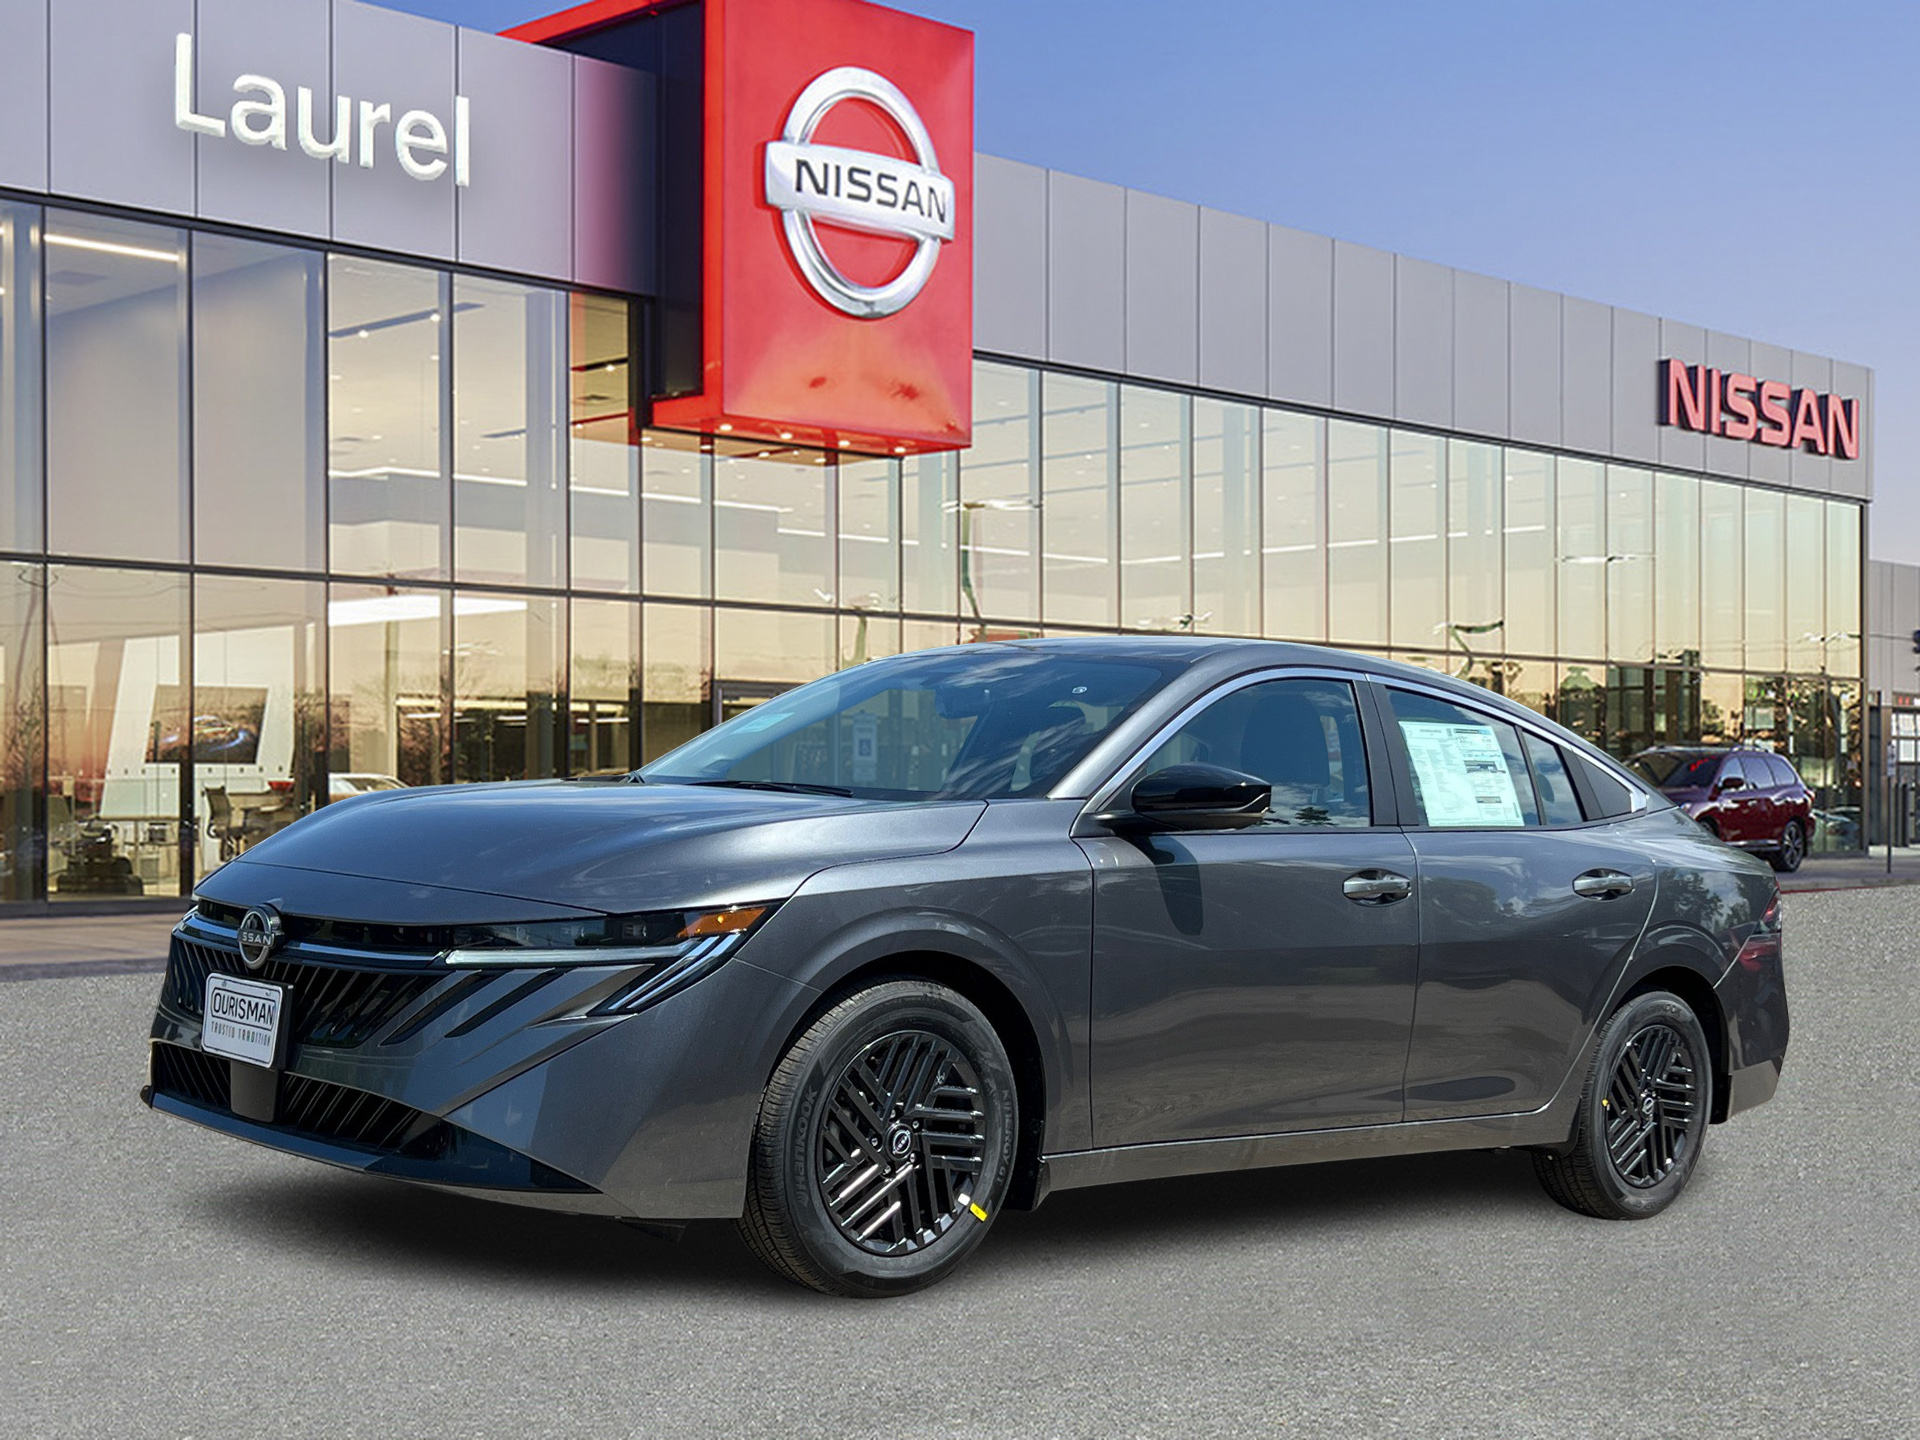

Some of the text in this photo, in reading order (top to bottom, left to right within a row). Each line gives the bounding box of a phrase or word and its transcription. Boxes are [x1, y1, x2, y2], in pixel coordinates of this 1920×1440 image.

[175, 33, 470, 187] Laurel
[795, 158, 946, 224] NISSAN
[1660, 358, 1860, 460] NISSAN
[242, 931, 271, 946] SSAN
[210, 1021, 236, 1039] TRUSTED
[213, 992, 274, 1025] OURISMAN
